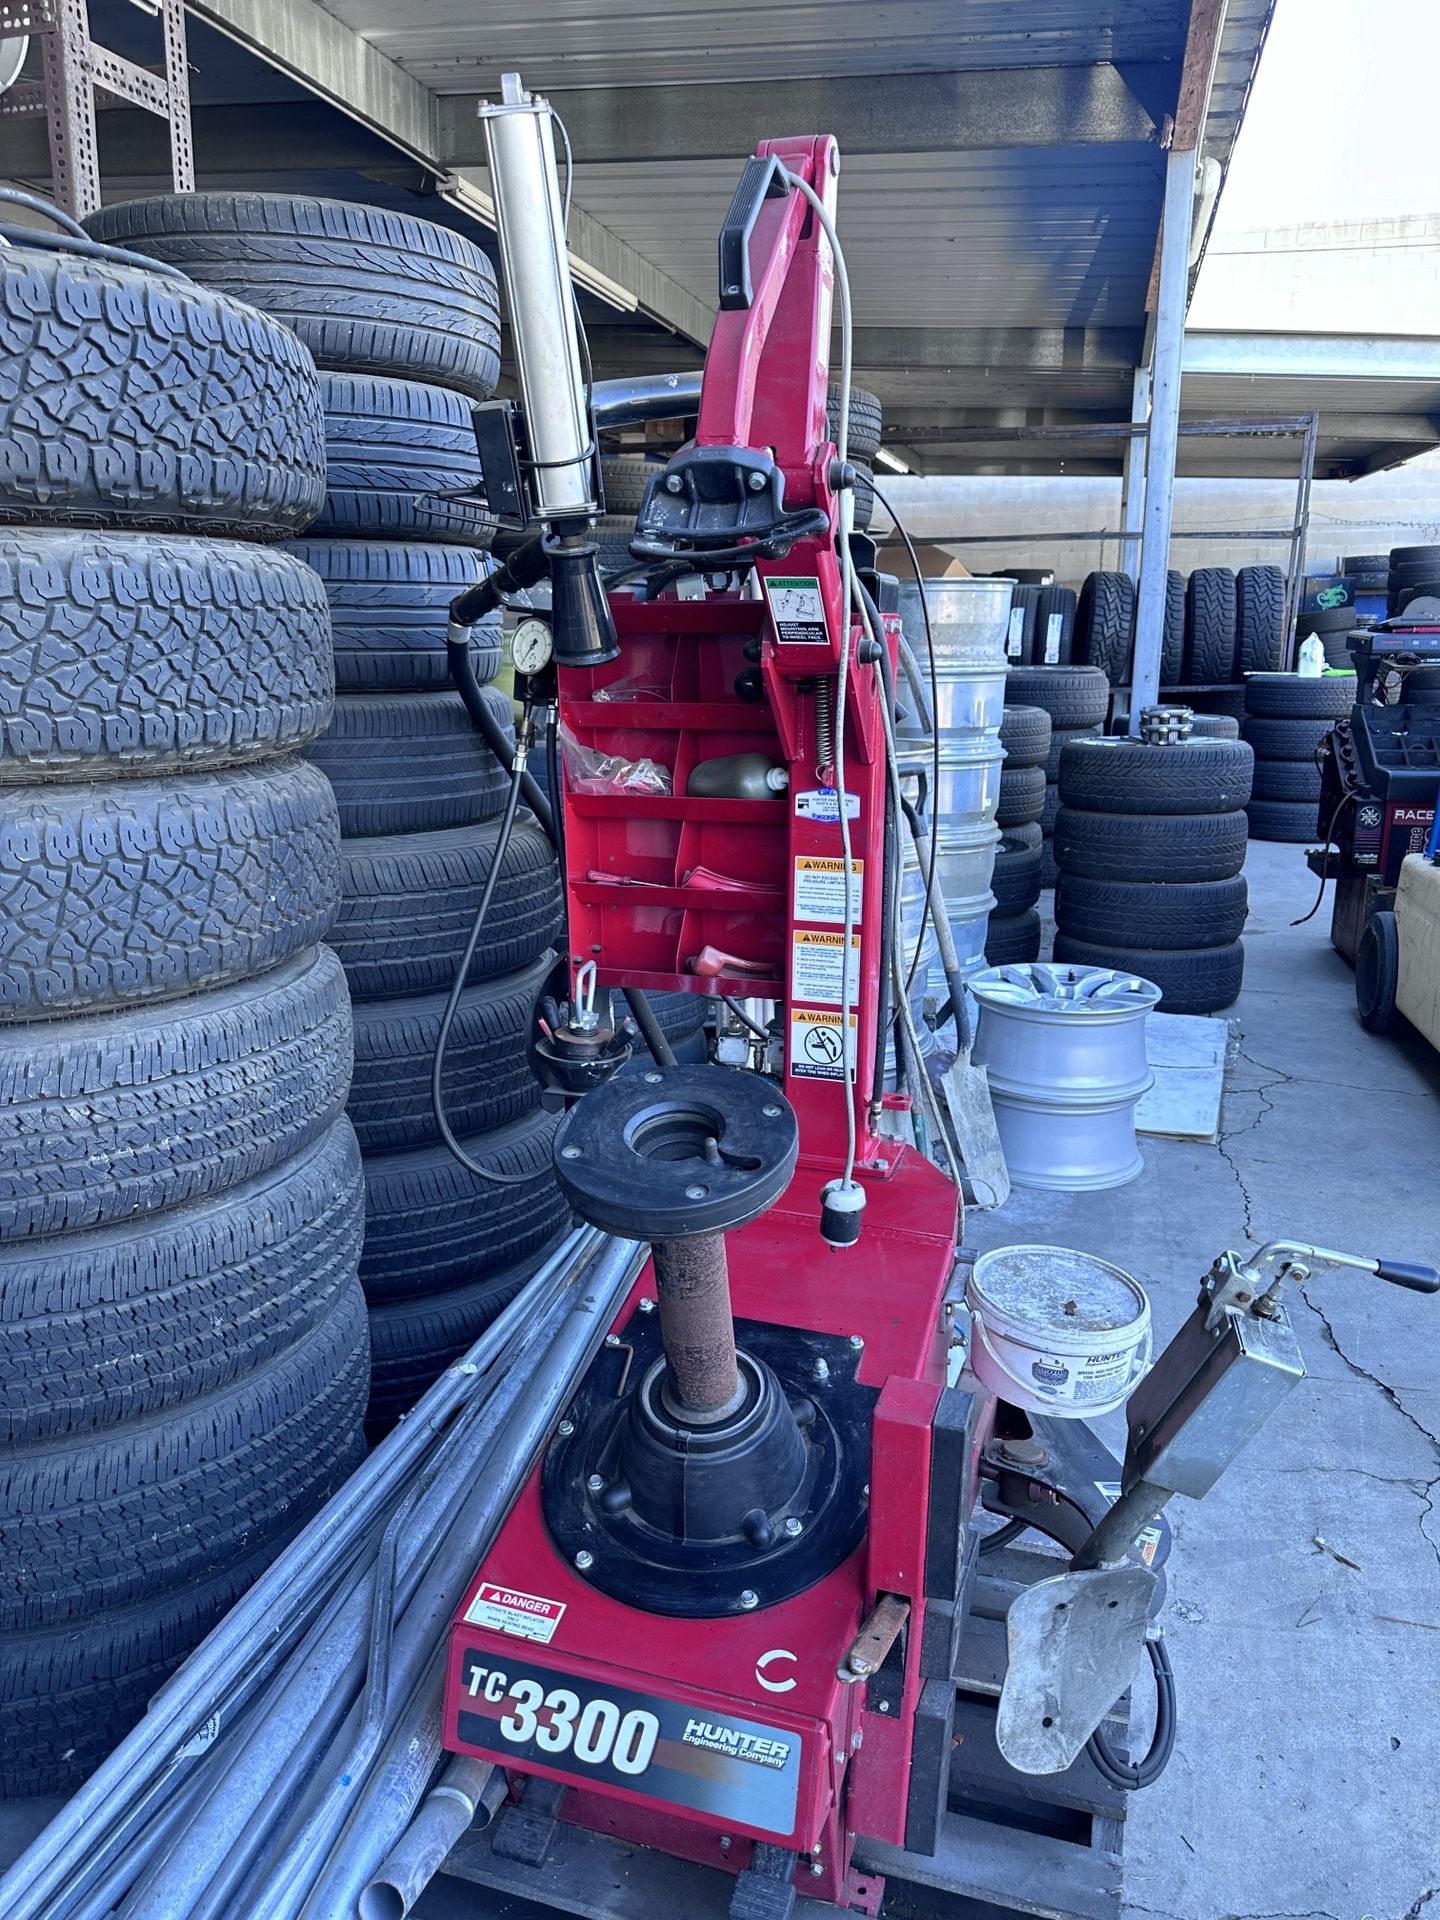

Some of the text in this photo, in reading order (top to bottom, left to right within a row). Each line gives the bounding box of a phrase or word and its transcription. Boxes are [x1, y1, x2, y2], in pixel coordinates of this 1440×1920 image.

[1394, 809, 1435, 820] RACE
[812, 861, 857, 872] WARNIG
[807, 1013, 844, 1024] WARNIN
[501, 1593, 551, 1614] DANGER
[486, 1605, 545, 1624] ACTIVATE BLAST INFLATOR
[487, 1615, 500, 1623] WHEN
[501, 1619, 520, 1628] SEATING
[685, 1719, 790, 1759] HUNTER
[682, 1732, 785, 1768] Engineering Company
